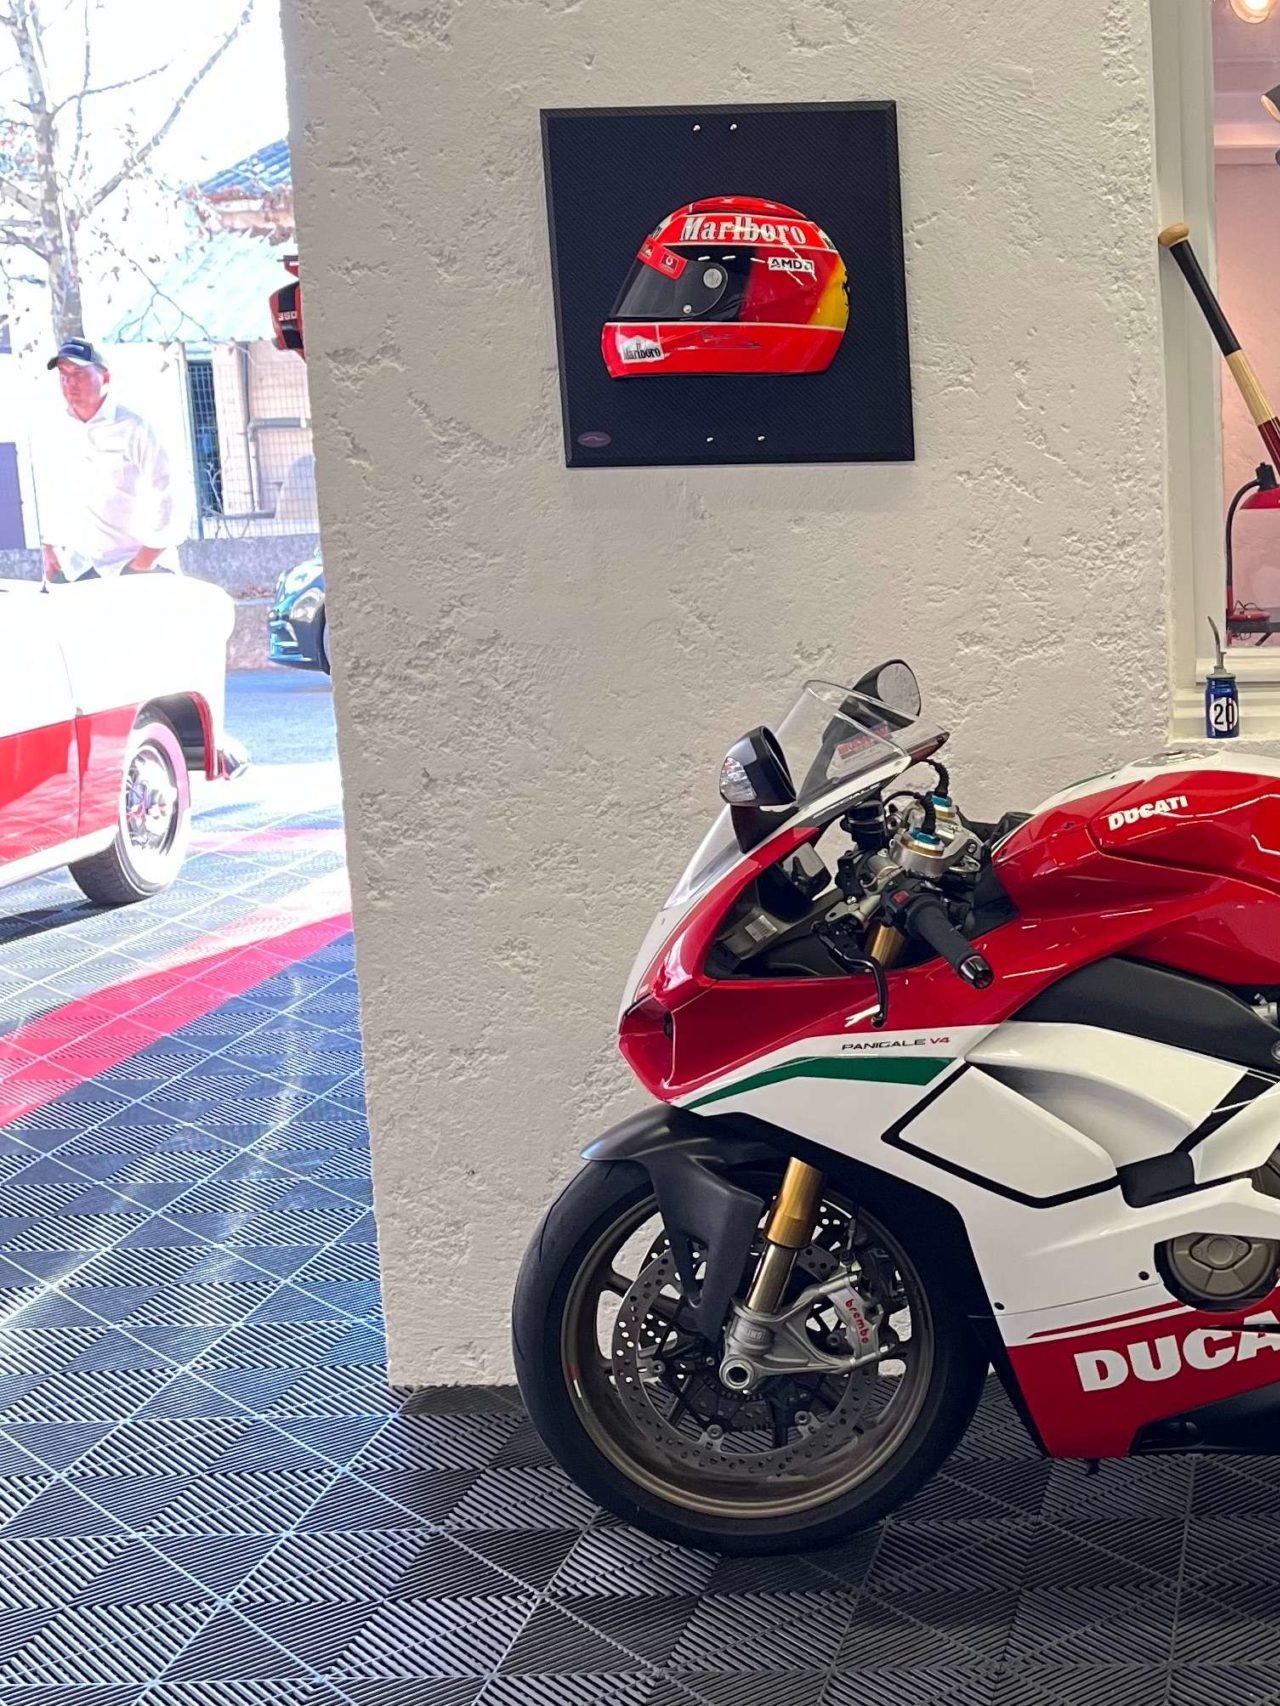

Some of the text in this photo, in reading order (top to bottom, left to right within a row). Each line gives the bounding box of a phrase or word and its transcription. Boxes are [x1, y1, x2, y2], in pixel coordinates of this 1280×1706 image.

[680, 215, 807, 245] Marlboro
[770, 258, 801, 270] AMD
[623, 346, 661, 361] Marlboro
[1213, 703, 1234, 725] 20
[1107, 795, 1188, 831] DUCATI
[841, 1036, 951, 1050] PANIGALE V4
[845, 1298, 870, 1344] brembo
